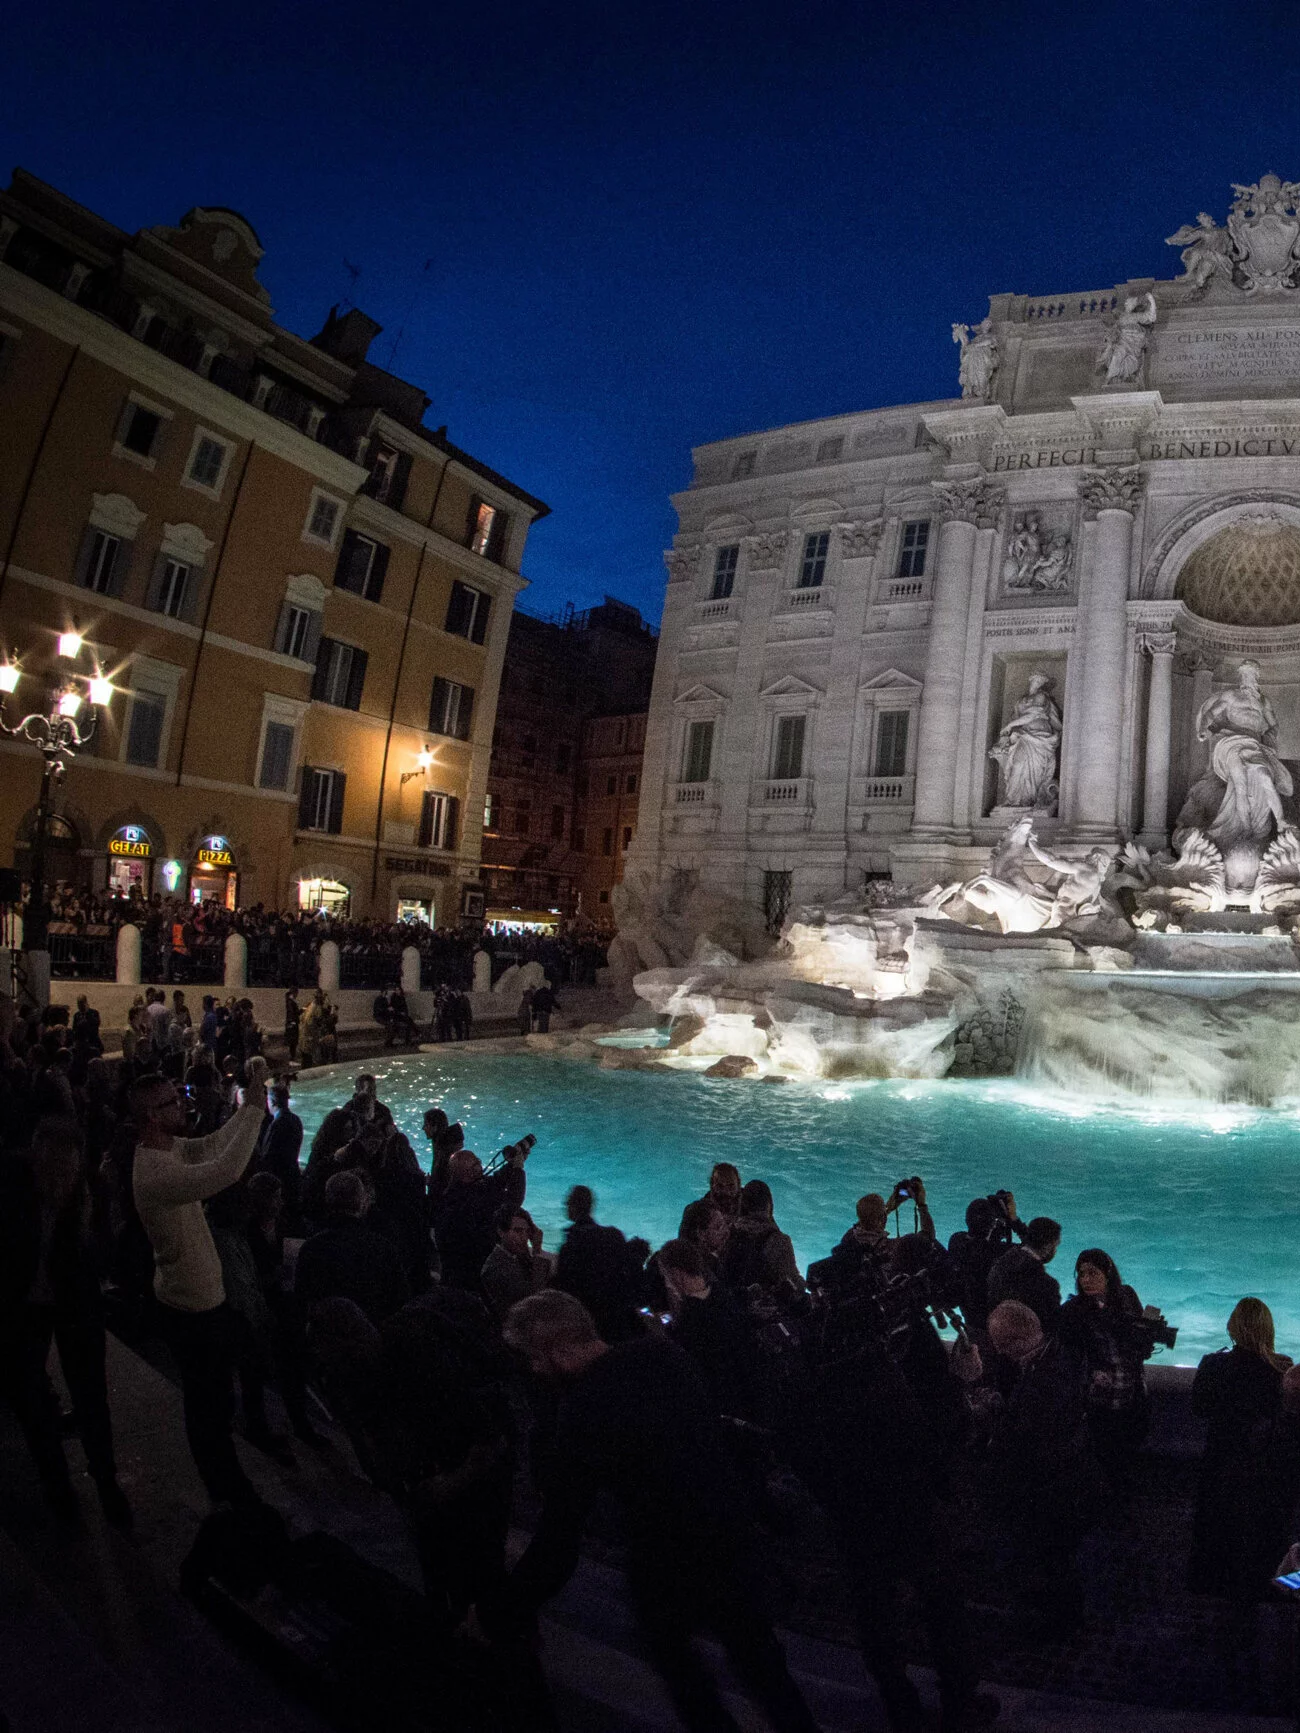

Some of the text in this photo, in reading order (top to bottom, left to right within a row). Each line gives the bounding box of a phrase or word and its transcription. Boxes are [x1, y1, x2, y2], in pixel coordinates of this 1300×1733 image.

[1177, 333, 1238, 344] CLEMENS
[993, 447, 1100, 472] PERFECIT
[109, 839, 149, 856] GELATI
[199, 849, 231, 865] PIZZA
